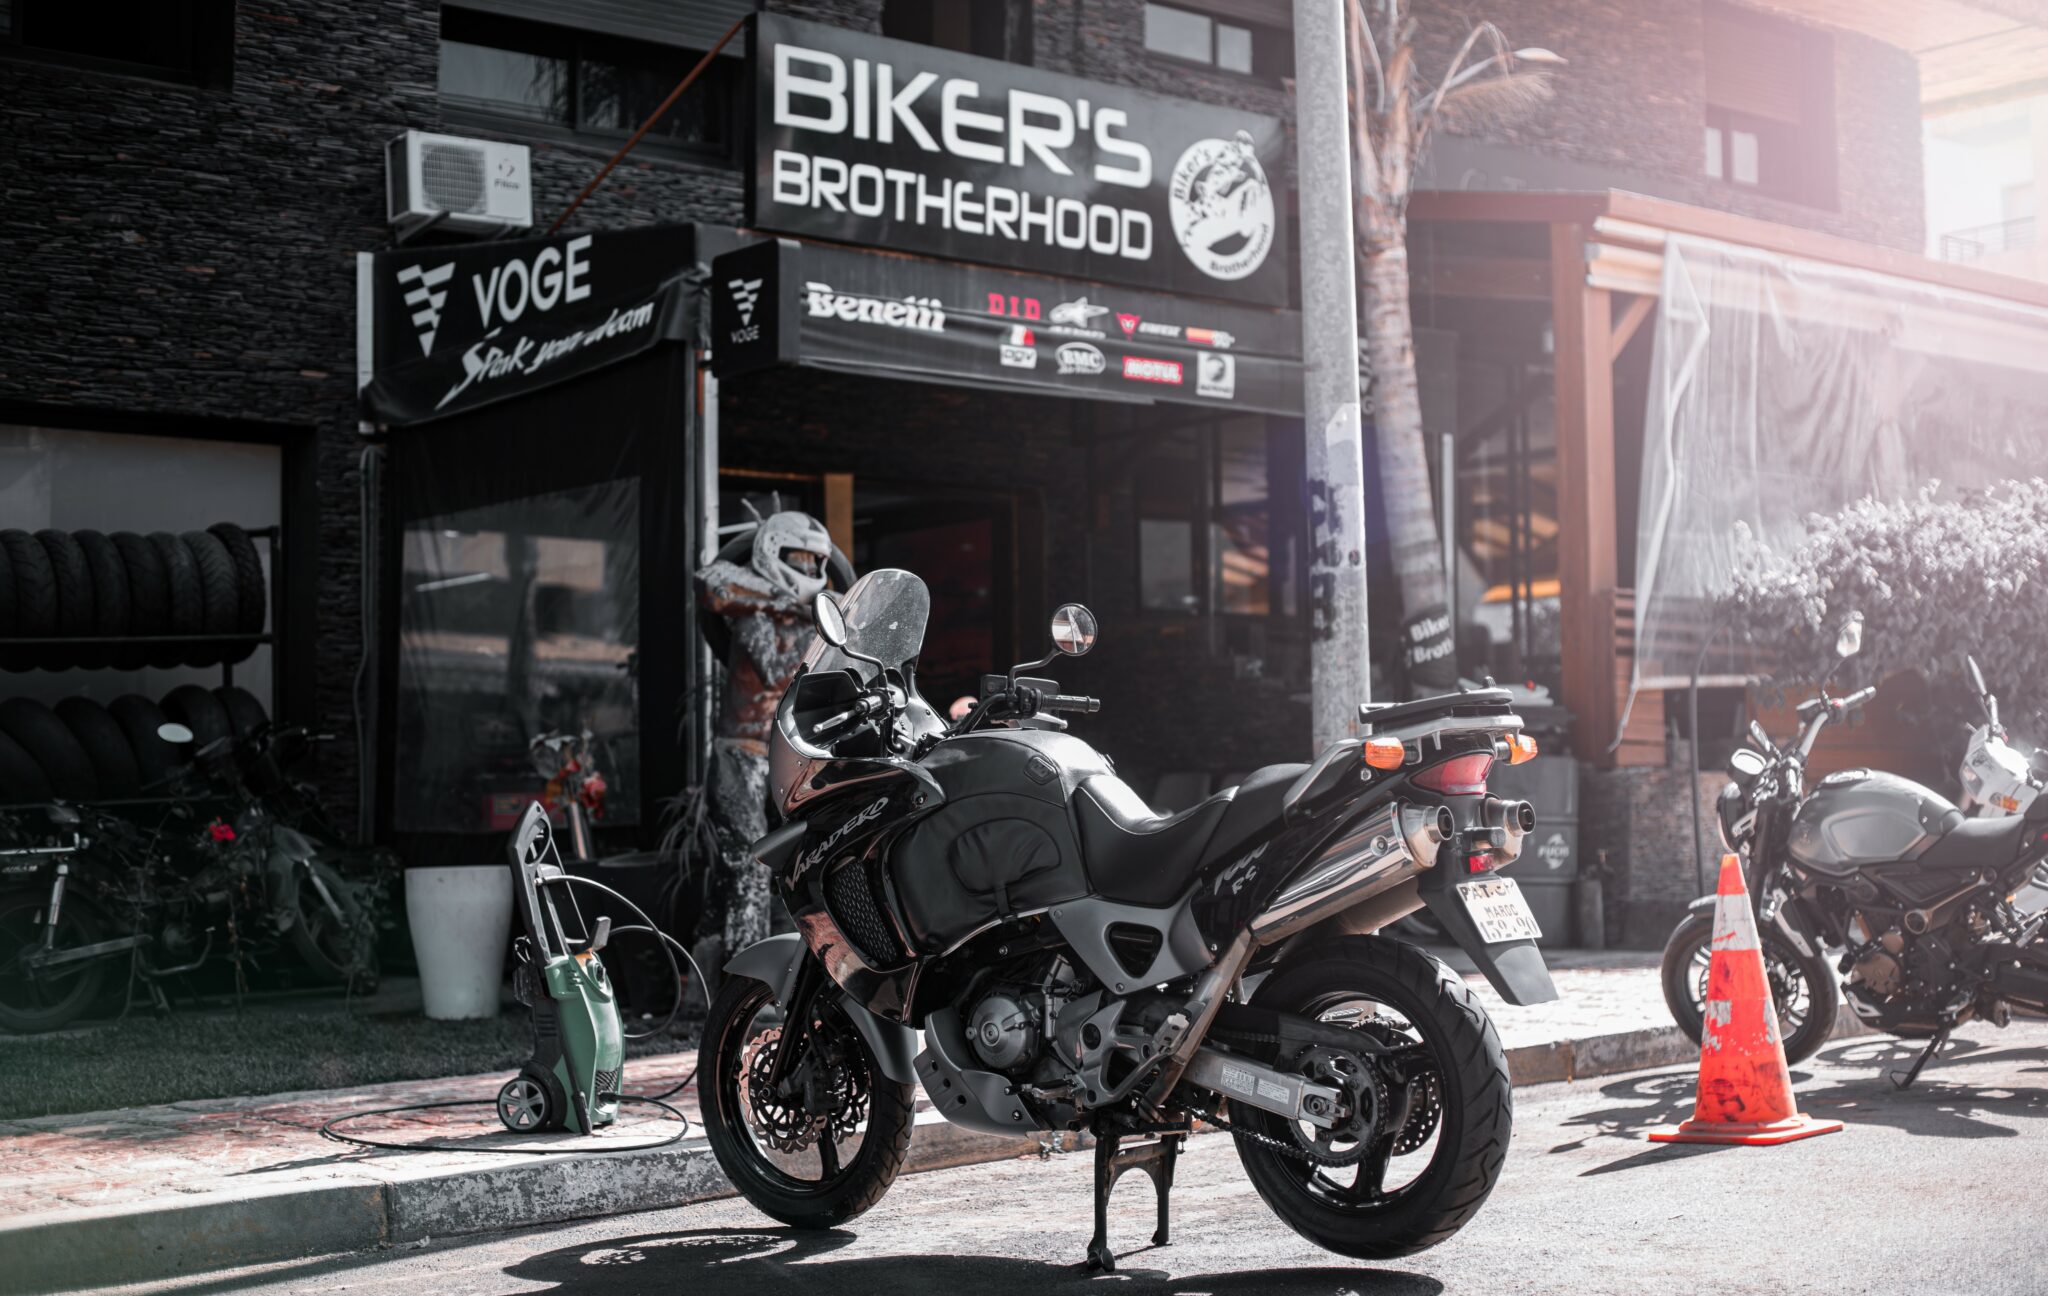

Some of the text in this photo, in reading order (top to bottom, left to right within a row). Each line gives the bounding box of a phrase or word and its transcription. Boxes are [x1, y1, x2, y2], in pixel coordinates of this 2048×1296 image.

[773, 42, 1153, 189] BIKER'S
[772, 149, 1153, 261] BROTHERHOOD
[472, 234, 592, 329] VOGE
[730, 324, 761, 344] VOGE
[1125, 359, 1182, 382] MOTUL
[1484, 904, 1518, 919] MAROC
